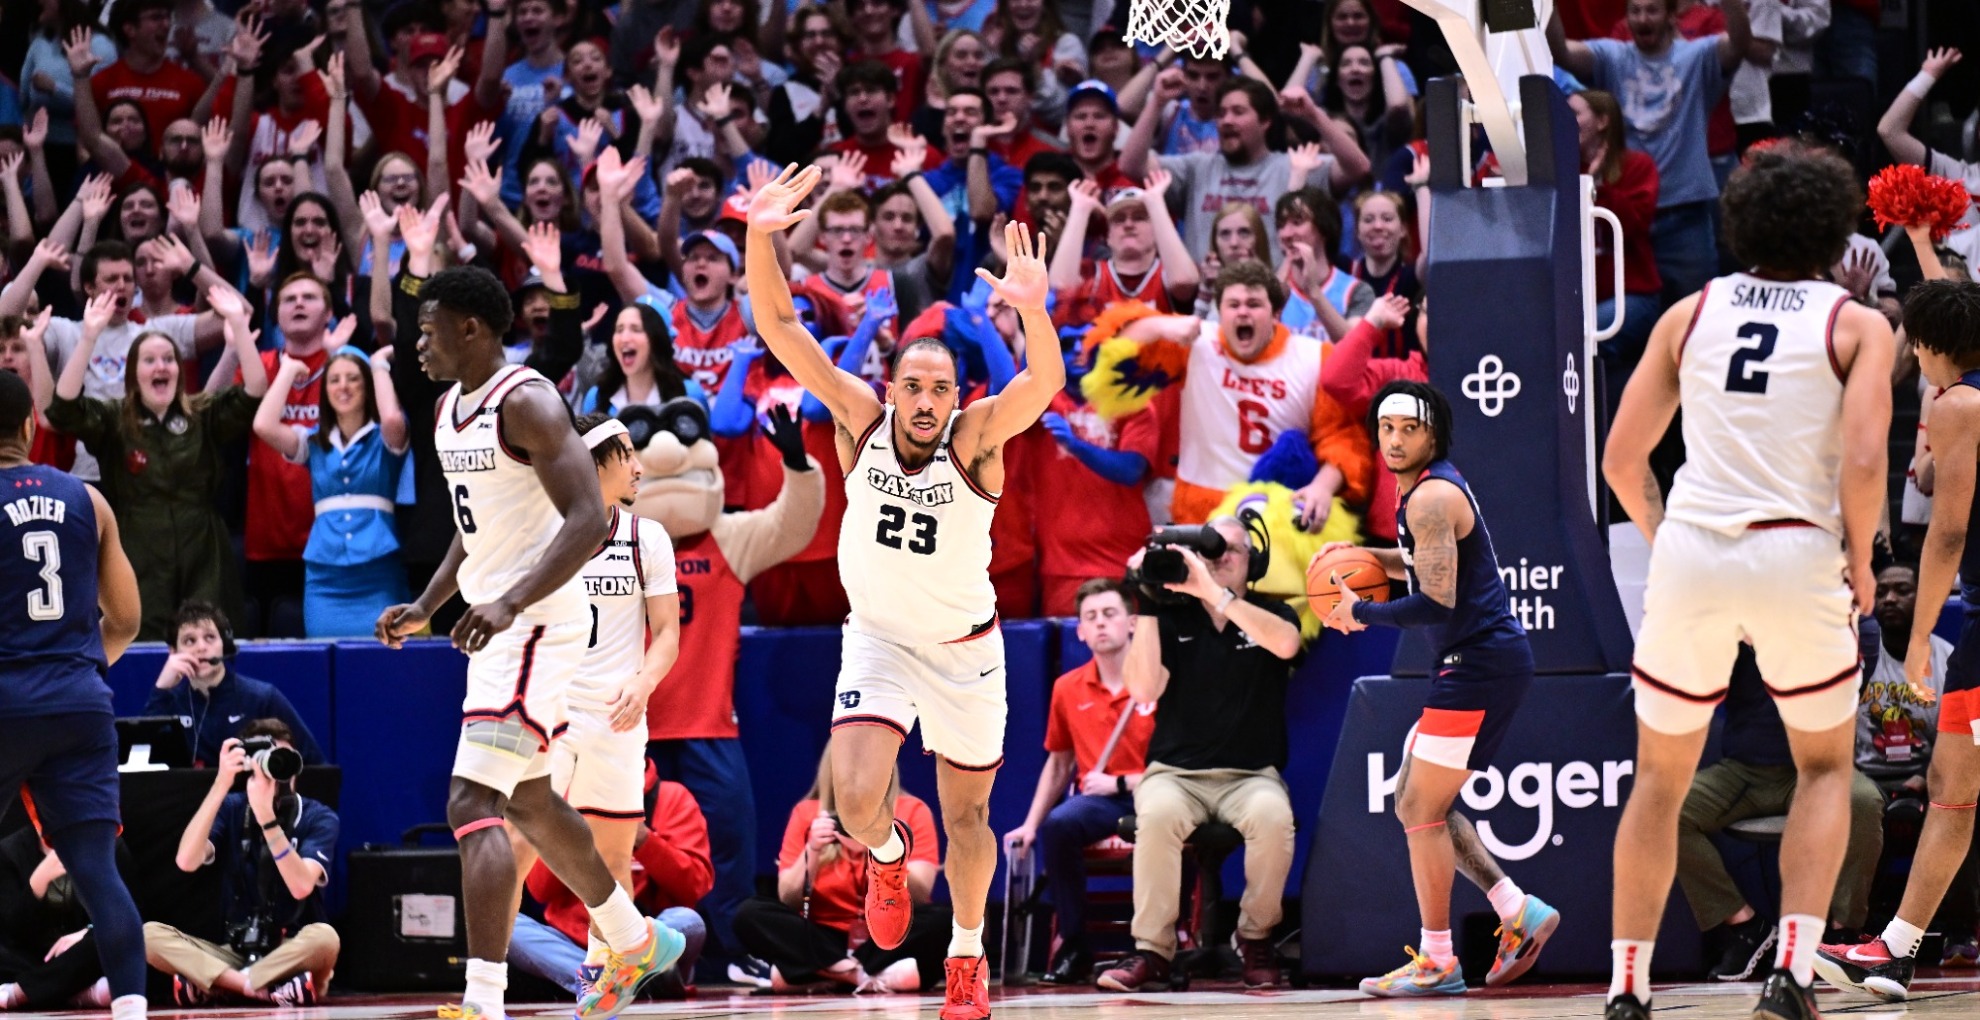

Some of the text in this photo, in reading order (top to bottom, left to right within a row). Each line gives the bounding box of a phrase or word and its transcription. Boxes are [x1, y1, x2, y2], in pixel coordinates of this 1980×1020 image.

[1731, 284, 1808, 311] SANTOS
[1725, 321, 1779, 394] 2
[1237, 400, 1273, 455] 6
[3, 495, 66, 527] ROZIER
[454, 484, 477, 534] 6
[867, 466, 954, 508] DAYTON
[876, 503, 938, 556] 23
[22, 529, 65, 621] 3
[1367, 752, 1634, 861] Koger
